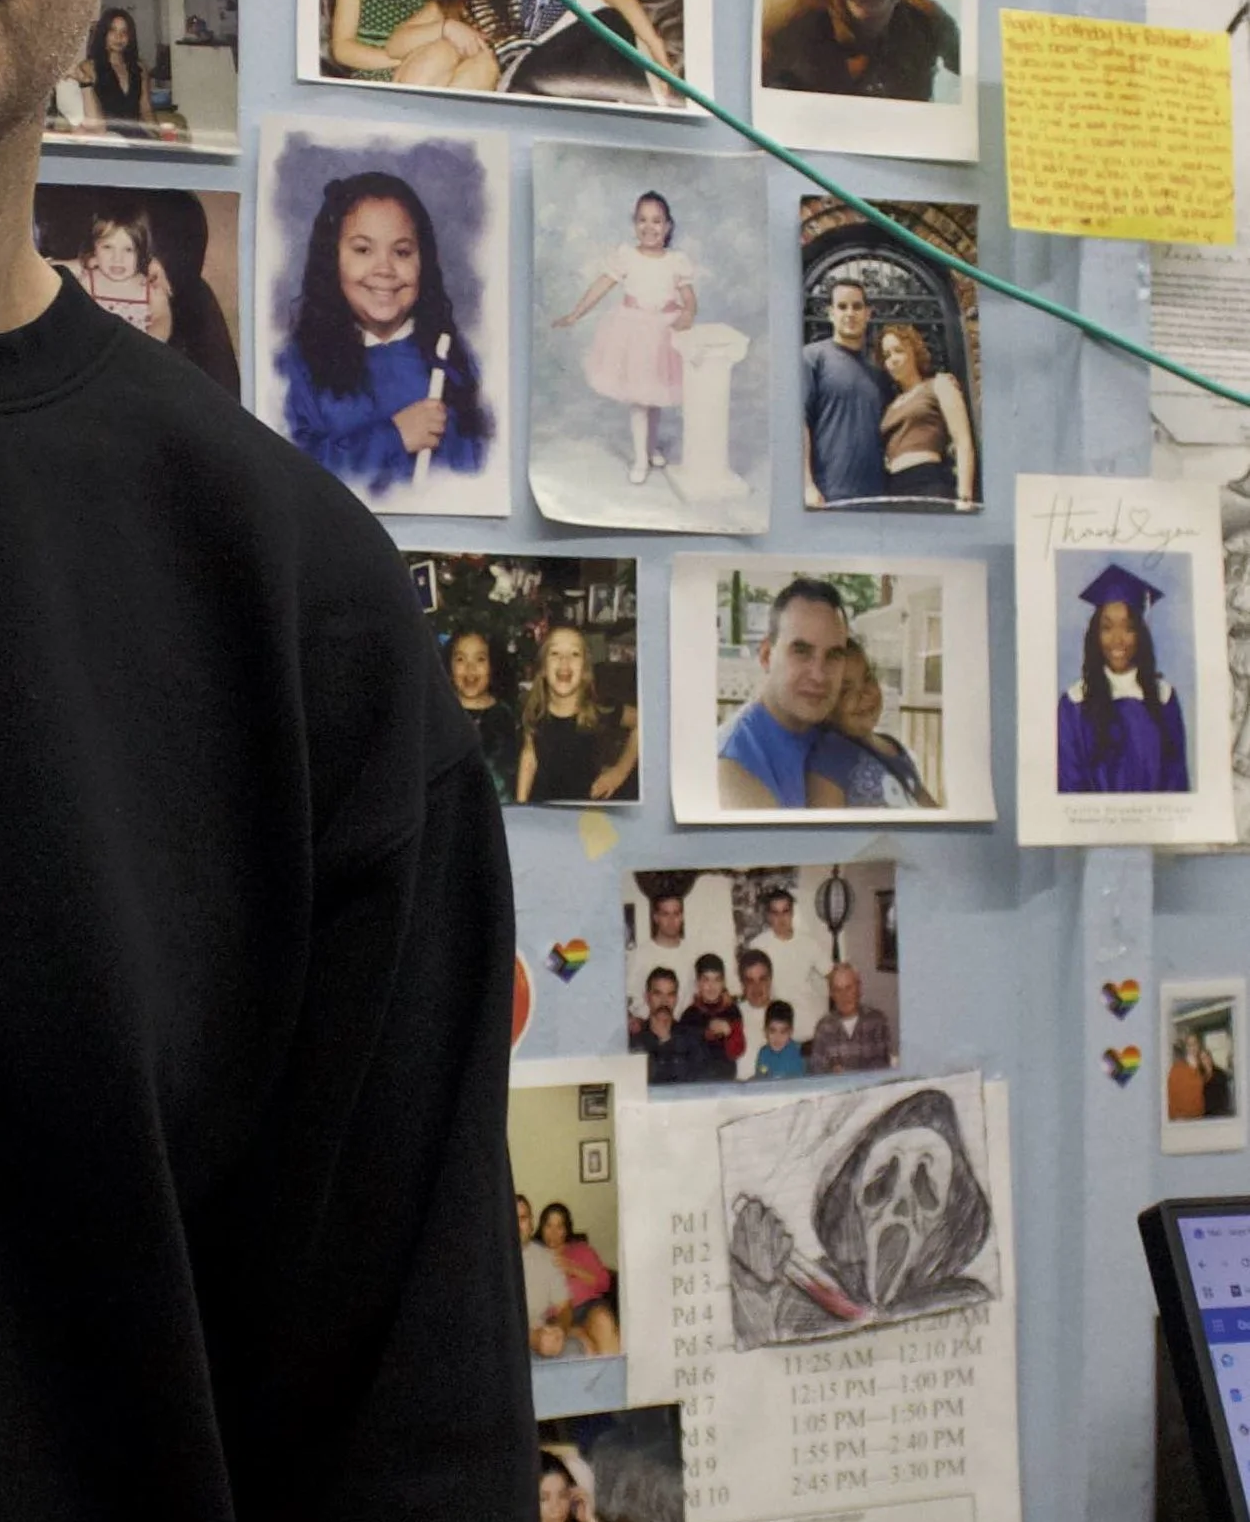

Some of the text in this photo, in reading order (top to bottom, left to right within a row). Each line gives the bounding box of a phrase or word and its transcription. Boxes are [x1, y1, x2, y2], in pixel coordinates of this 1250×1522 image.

[671, 1213, 694, 1234] Pd
[672, 1242, 711, 1265] Pd 2
[672, 1273, 711, 1296] Pd 3
[672, 1304, 714, 1326] Pd 4
[674, 1336, 697, 1357] Pd
[703, 1335, 714, 1354] 5
[674, 1367, 697, 1388] Pd
[703, 1366, 715, 1385] 6
[952, 1336, 982, 1358] PM
[943, 1367, 975, 1388] PM
[933, 1398, 964, 1419] PM
[705, 1457, 716, 1473] 9
[934, 1428, 965, 1449] PM
[708, 1486, 729, 1506] 10
[934, 1457, 966, 1478] PM
